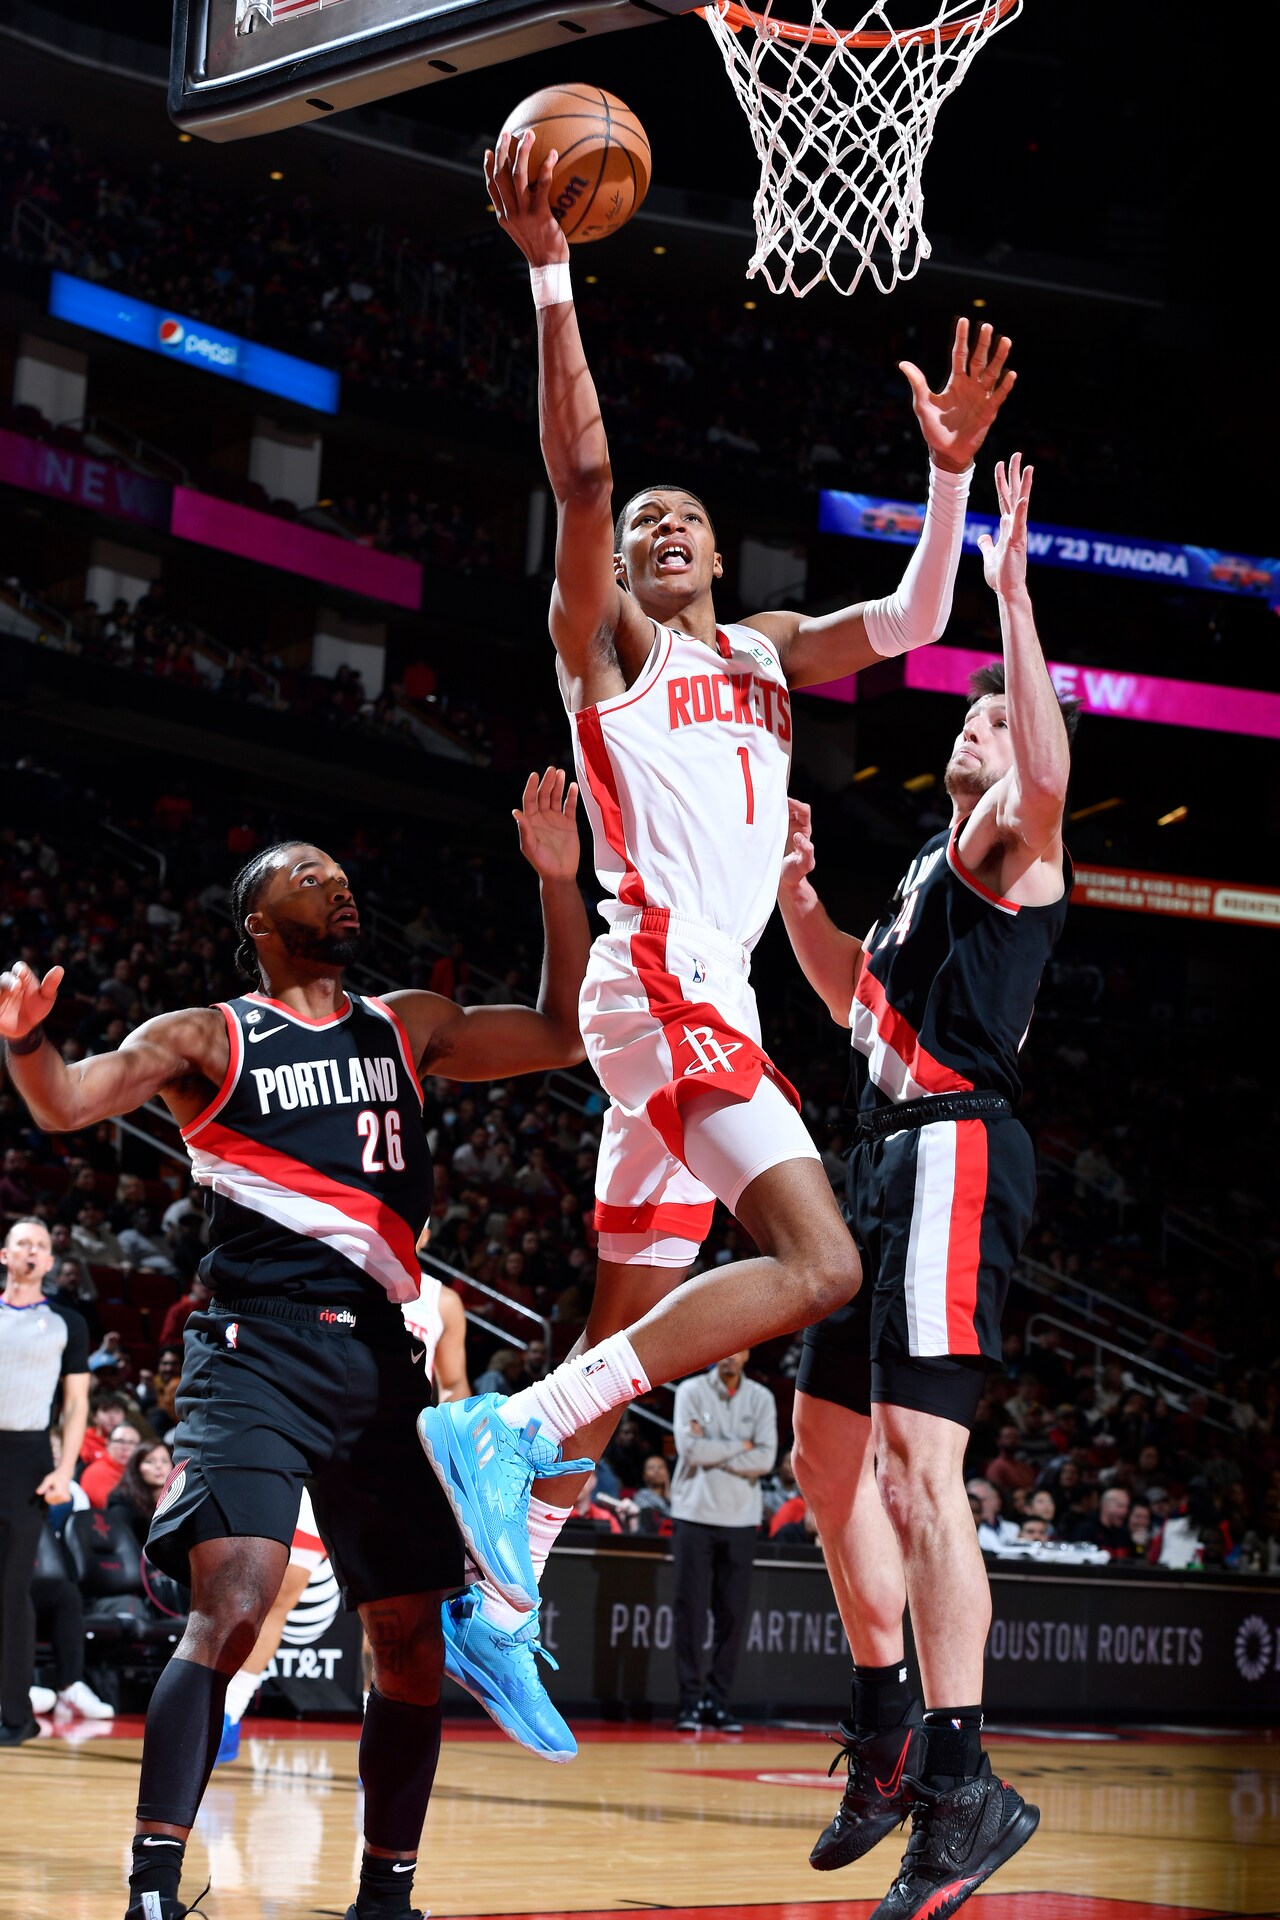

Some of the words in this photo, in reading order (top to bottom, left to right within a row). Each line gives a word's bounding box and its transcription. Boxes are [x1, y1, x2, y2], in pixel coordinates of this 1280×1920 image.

[185, 334, 237, 365] pepsi
[43, 449, 163, 519] NEW
[1055, 536, 1089, 563] '23
[1092, 541, 1189, 577] TUNDRA
[667, 671, 791, 743] ROCKETS
[1050, 665, 1136, 711] EW
[736, 746, 755, 826] 1
[244, 1009, 262, 1024] 6
[250, 1057, 398, 1115] PORTLAND
[356, 1108, 405, 1174] 26
[320, 1309, 357, 1328] ripcity
[261, 1647, 343, 1679] AT&T
[1097, 1624, 1203, 1666] ROCKETS
